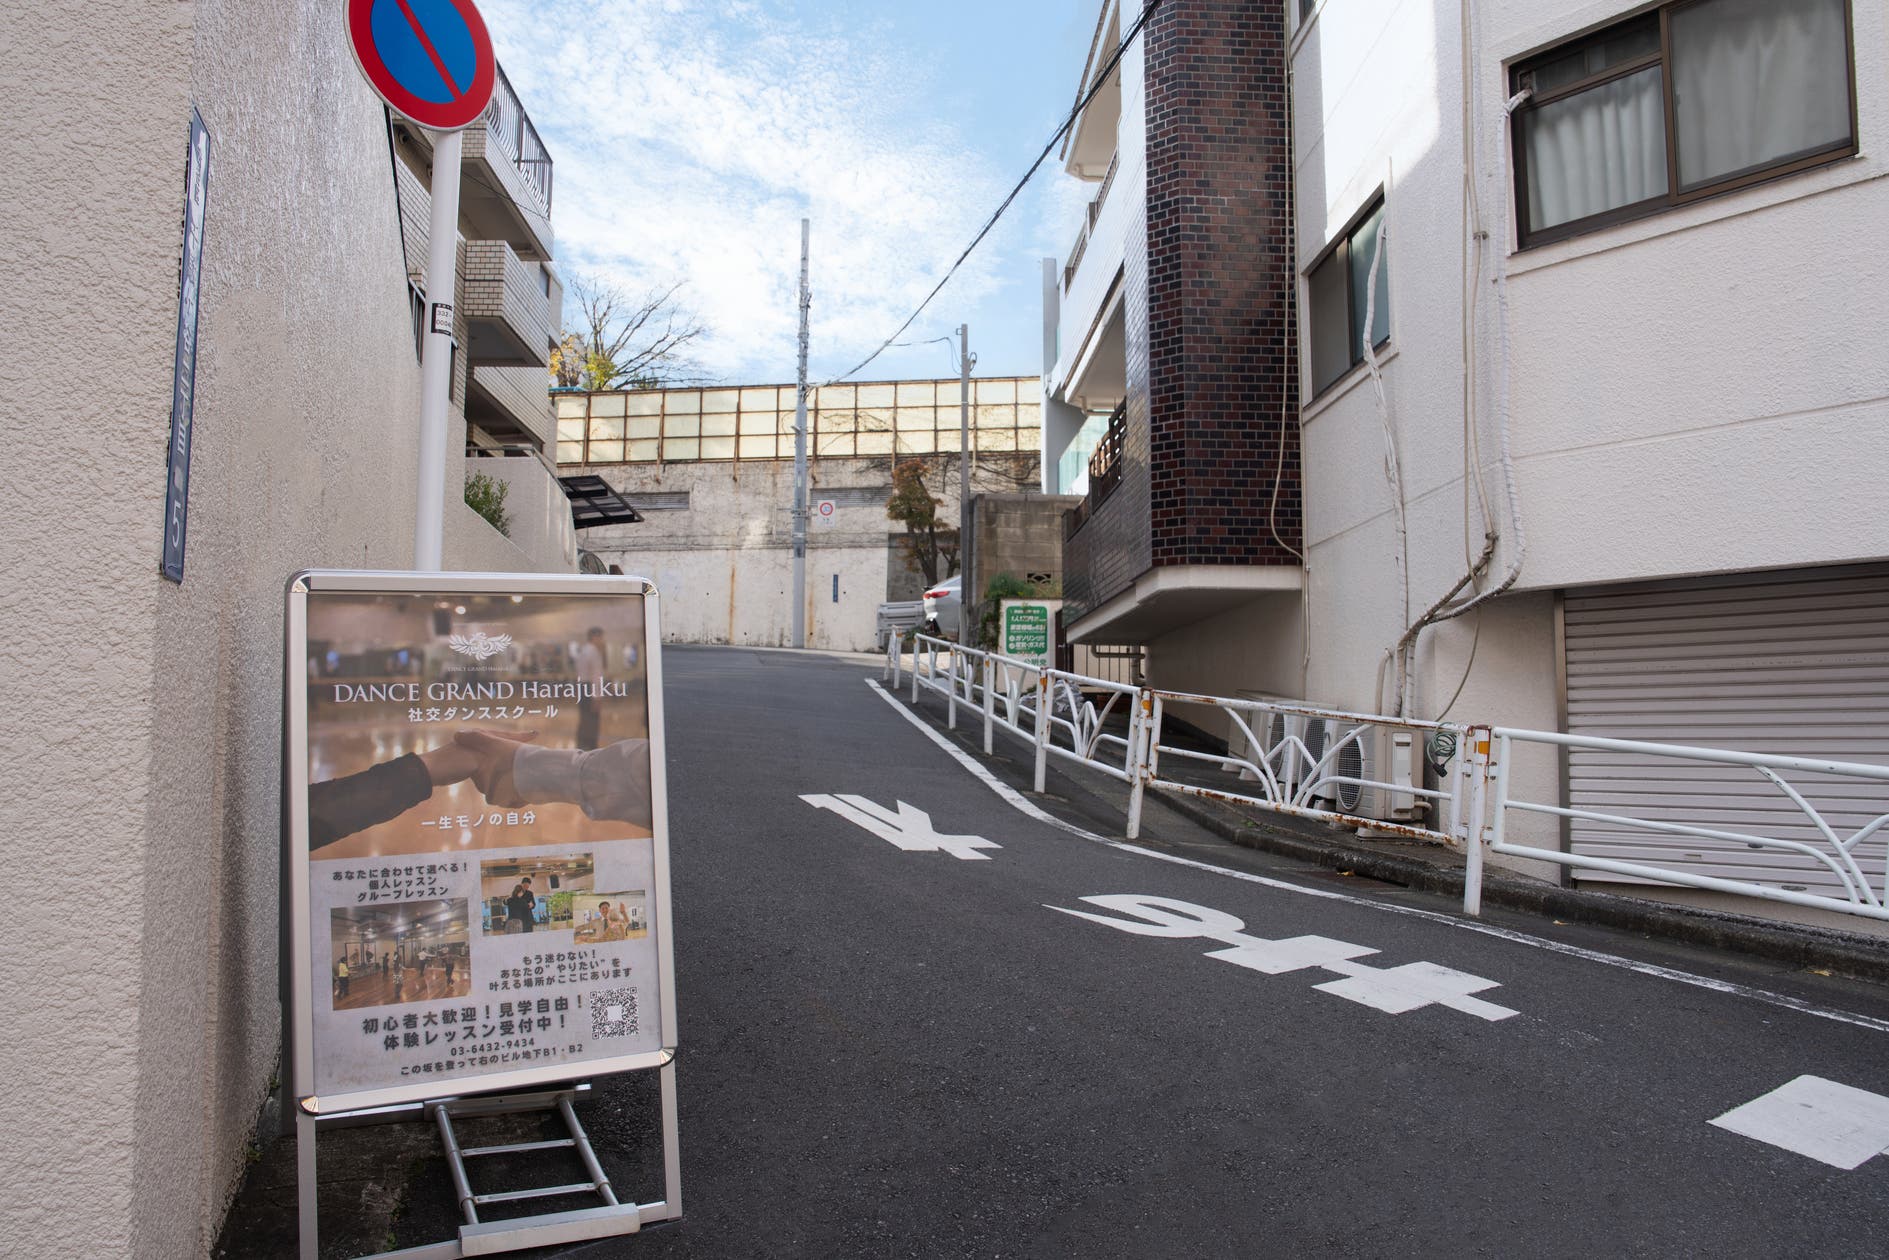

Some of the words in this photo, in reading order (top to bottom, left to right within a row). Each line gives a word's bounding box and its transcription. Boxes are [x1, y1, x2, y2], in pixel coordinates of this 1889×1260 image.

[172, 499, 182, 549] 5
[334, 683, 420, 703] DANCE
[427, 681, 514, 701] GRAND
[521, 676, 628, 704] Harajuku
[407, 704, 559, 722] 社交ダンススクール
[421, 811, 537, 830] 一生モノの自分
[368, 876, 437, 891] 個人レッスン
[357, 886, 449, 903] グループレッスン
[489, 967, 633, 991] 叶える場所がここにあります
[383, 1013, 566, 1052] 体験レッスン受付中！
[450, 1037, 536, 1058] 03-6432-9434
